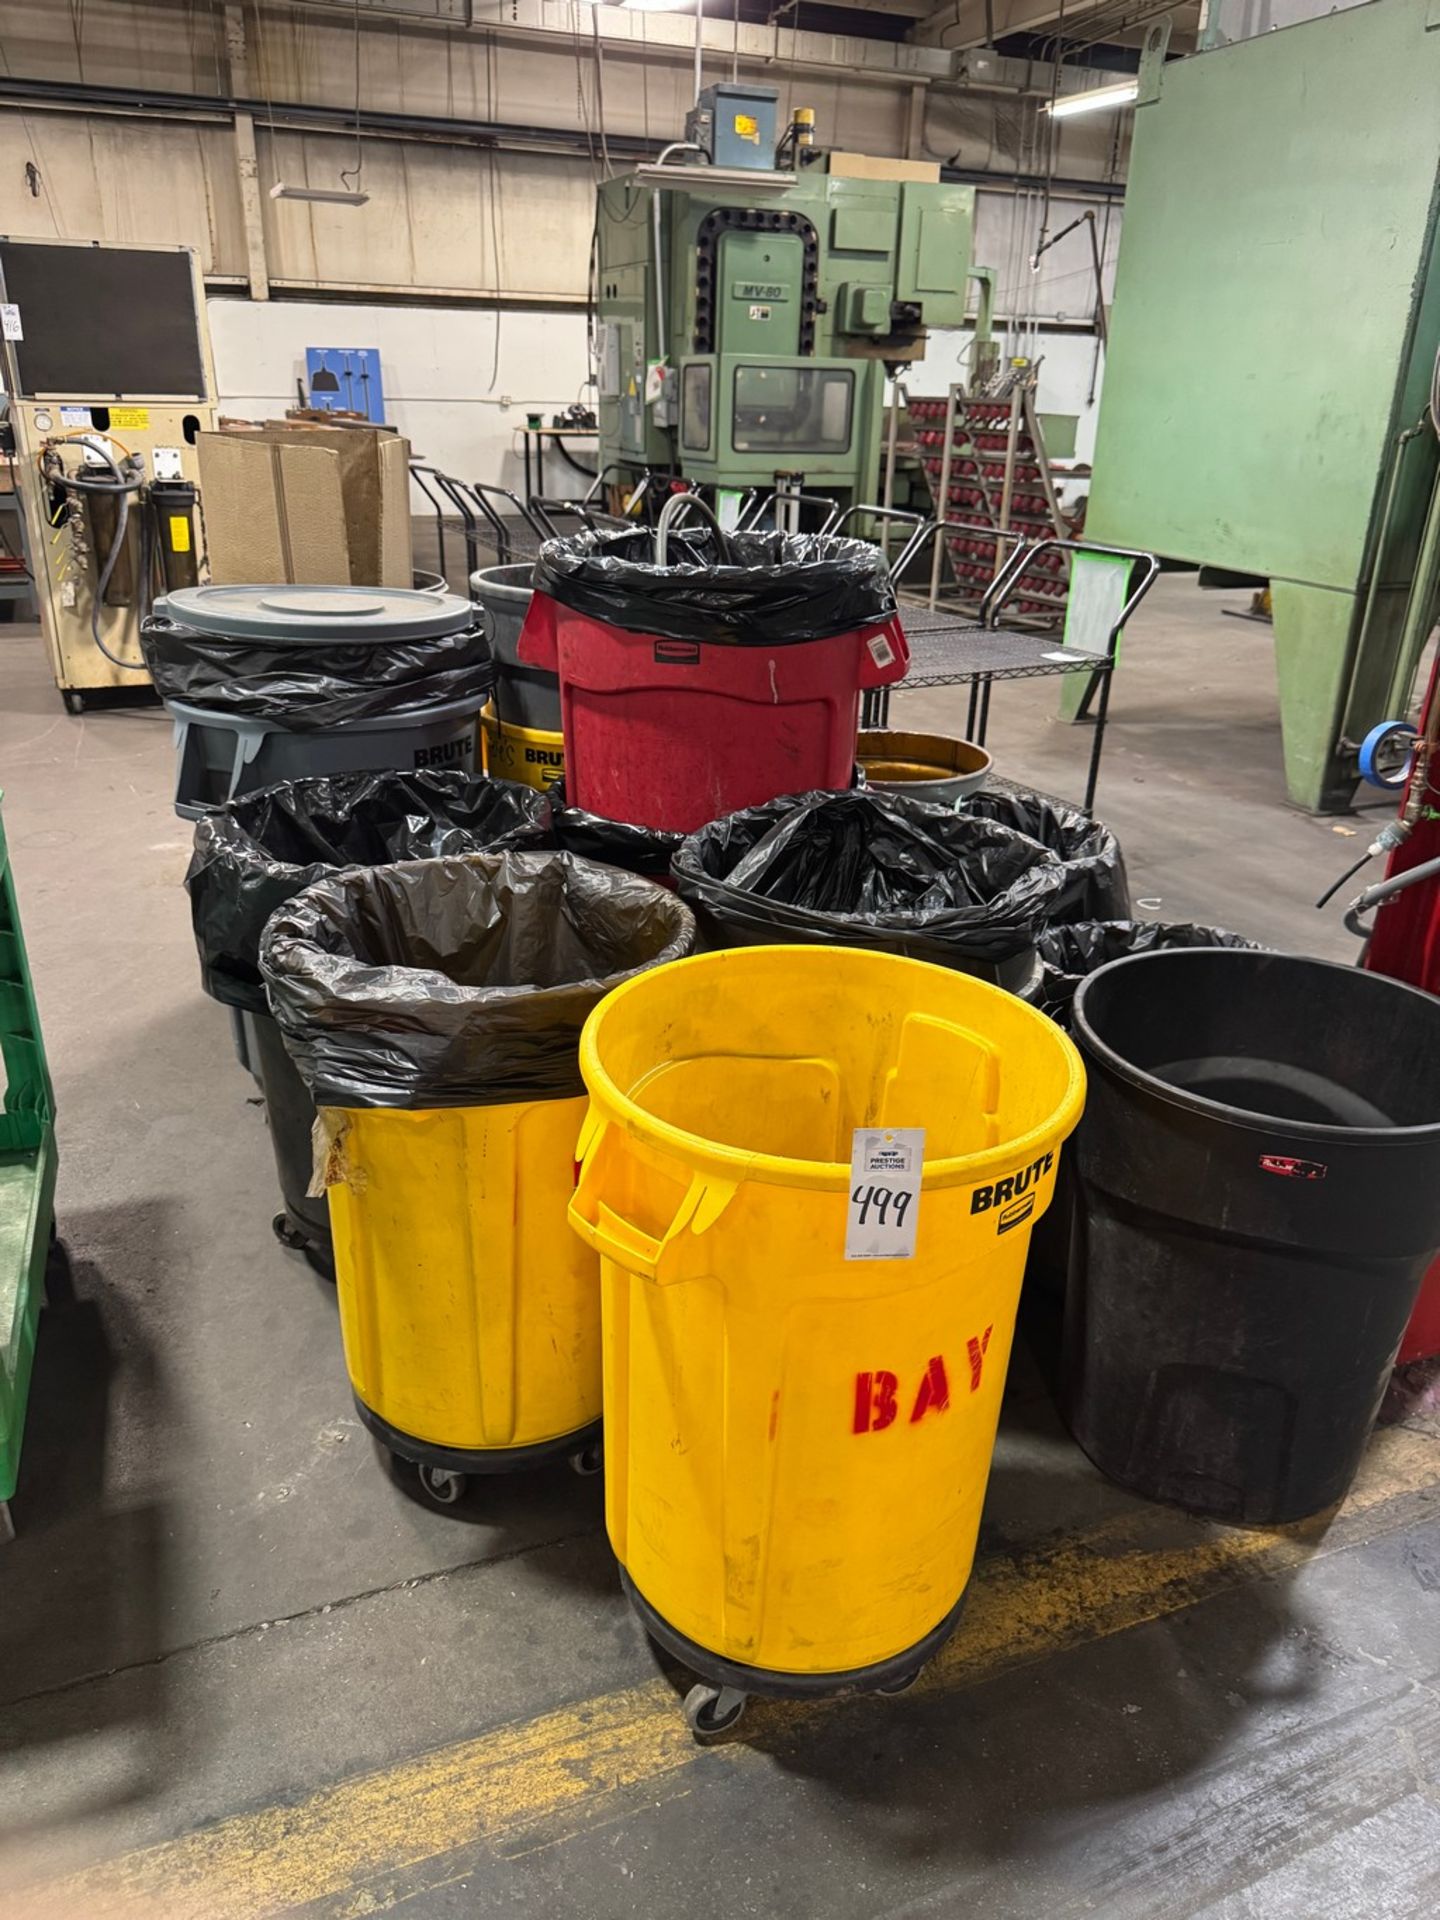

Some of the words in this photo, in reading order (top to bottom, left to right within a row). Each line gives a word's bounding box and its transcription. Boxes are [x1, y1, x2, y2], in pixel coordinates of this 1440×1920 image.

[414, 735, 473, 768] BRUTE
[525, 748, 565, 766] BRU
[970, 1151, 1054, 1215] BRUTE
[852, 1185, 912, 1227] 499
[853, 1323, 993, 1435] BAY
